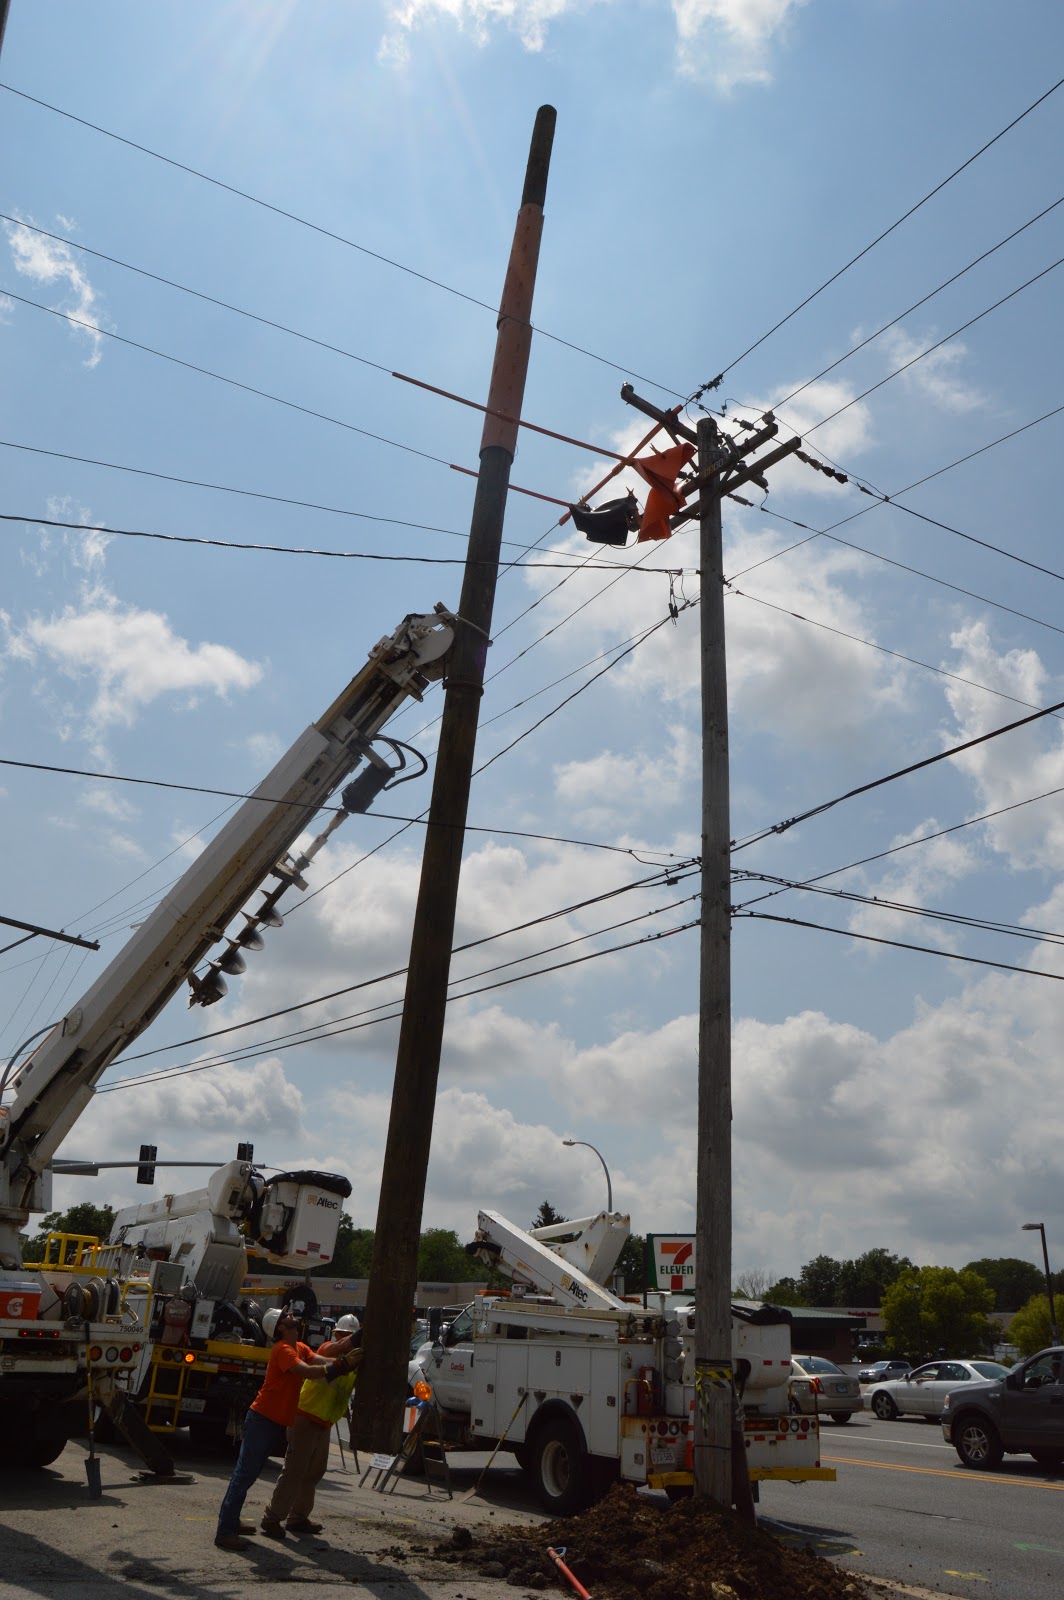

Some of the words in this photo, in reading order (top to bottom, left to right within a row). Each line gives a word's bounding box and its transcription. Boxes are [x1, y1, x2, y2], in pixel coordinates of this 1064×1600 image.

[316, 1197, 339, 1210] Altec
[660, 1265, 693, 1275] ELEVEN
[661, 1243, 692, 1290] 7
[568, 1281, 588, 1303] Altec
[7, 1297, 24, 1317] G
[120, 1325, 144, 1333] 750045
